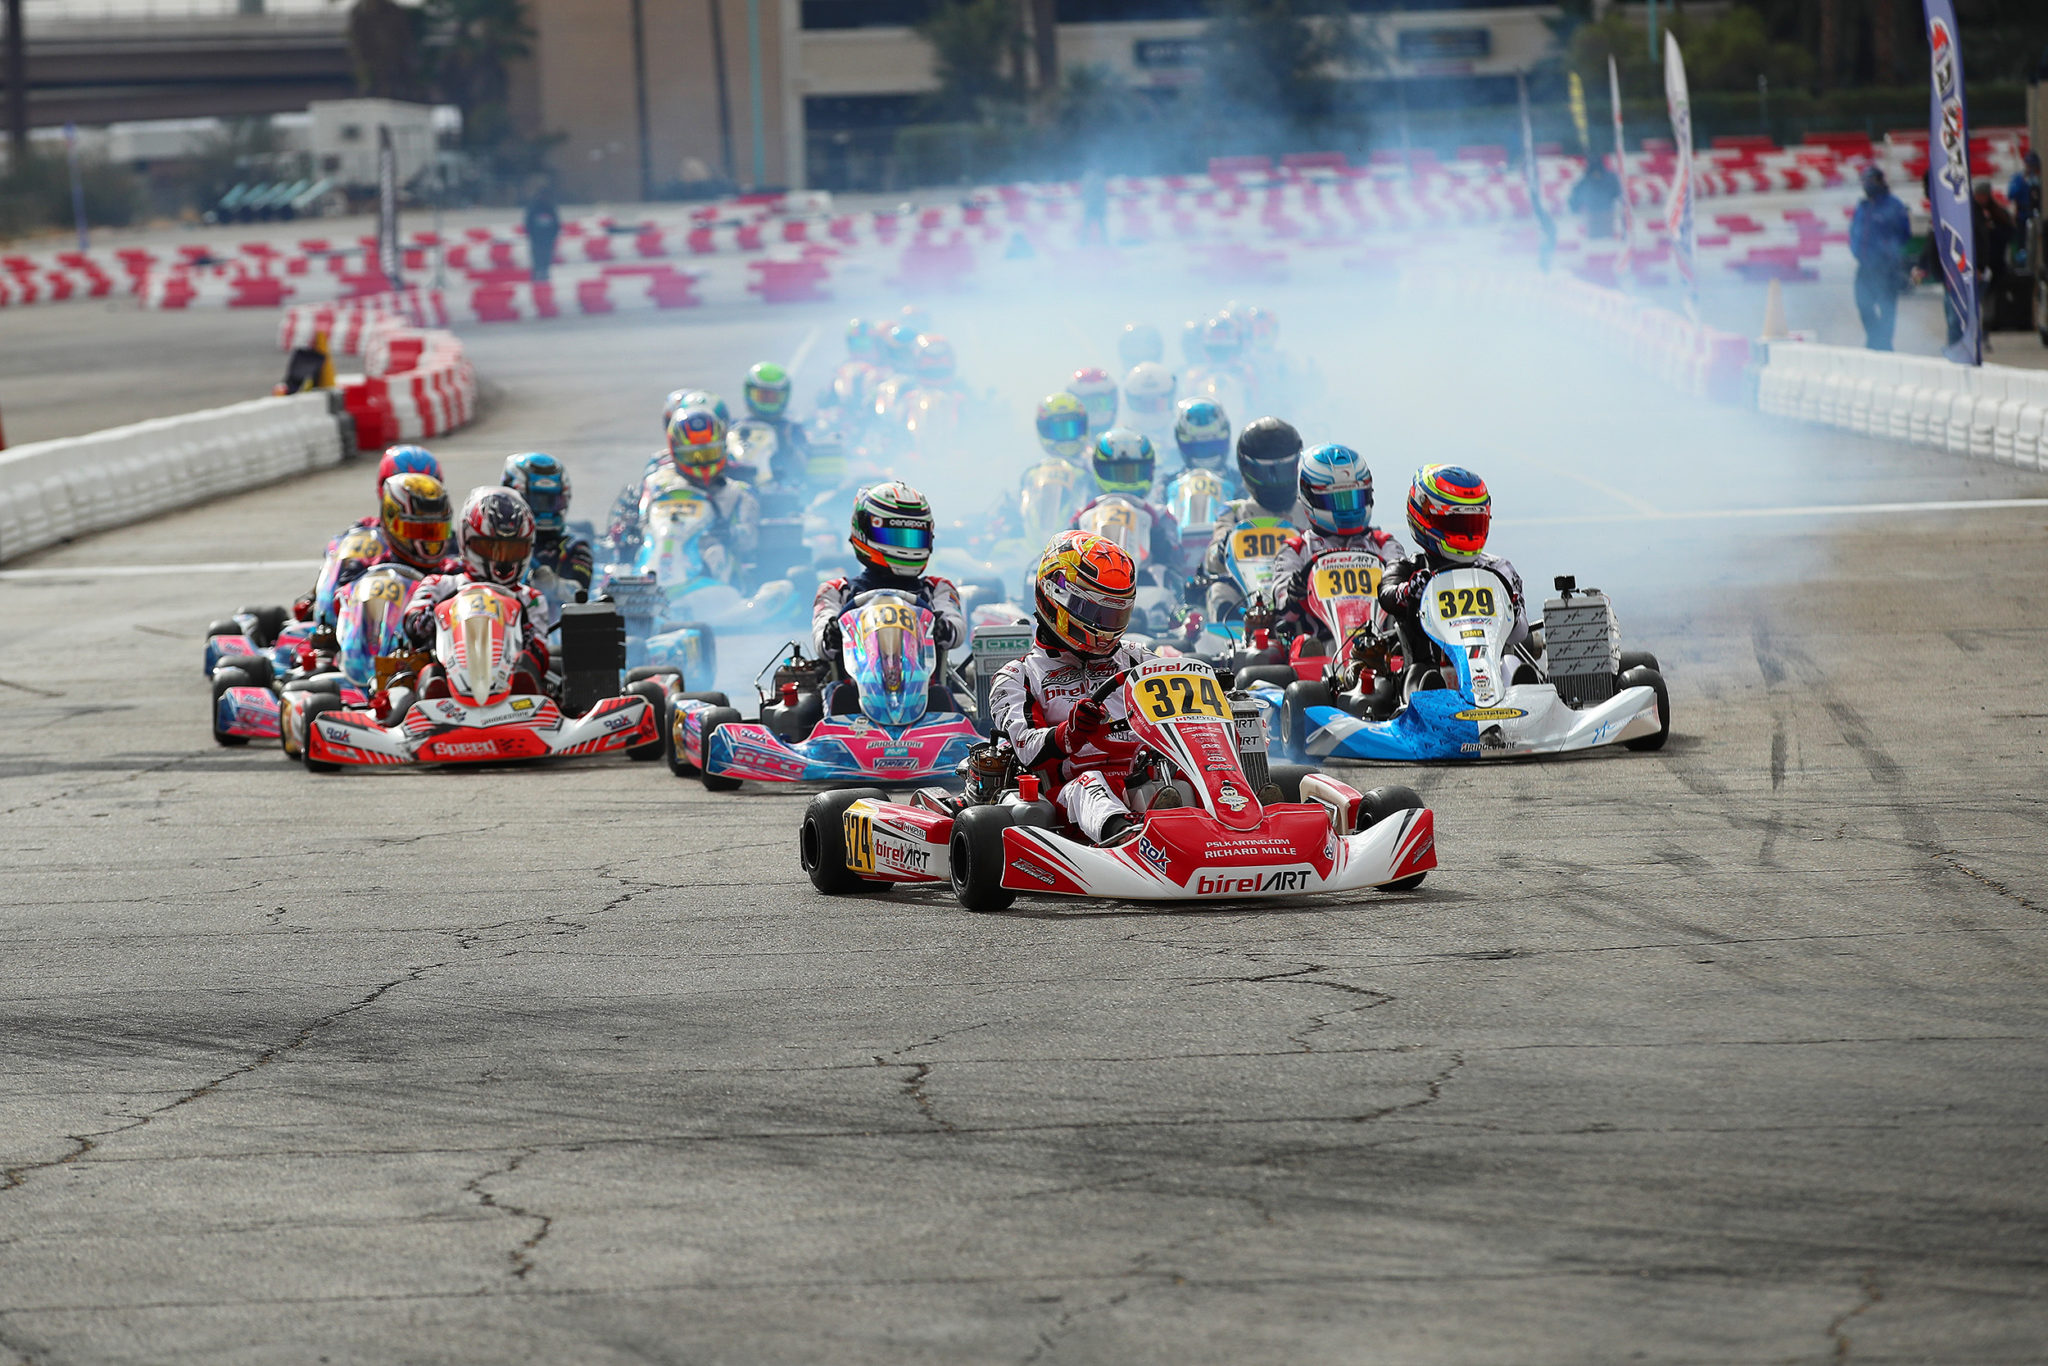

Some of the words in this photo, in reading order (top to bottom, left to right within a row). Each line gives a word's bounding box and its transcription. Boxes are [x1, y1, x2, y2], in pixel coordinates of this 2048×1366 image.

[1328, 569, 1373, 595] 309
[1438, 588, 1496, 619] 329
[864, 606, 914, 633] 08
[987, 639, 1028, 649] OTK
[1142, 663, 1212, 676] birelART
[1144, 677, 1224, 718] 324
[433, 739, 499, 756] Speed
[876, 838, 931, 870] birelART
[1204, 847, 1259, 859] RICHARD
[1261, 847, 1297, 856] MILLE
[1206, 839, 1290, 848] PSLKARTING.COM
[1197, 870, 1312, 895] birelART
